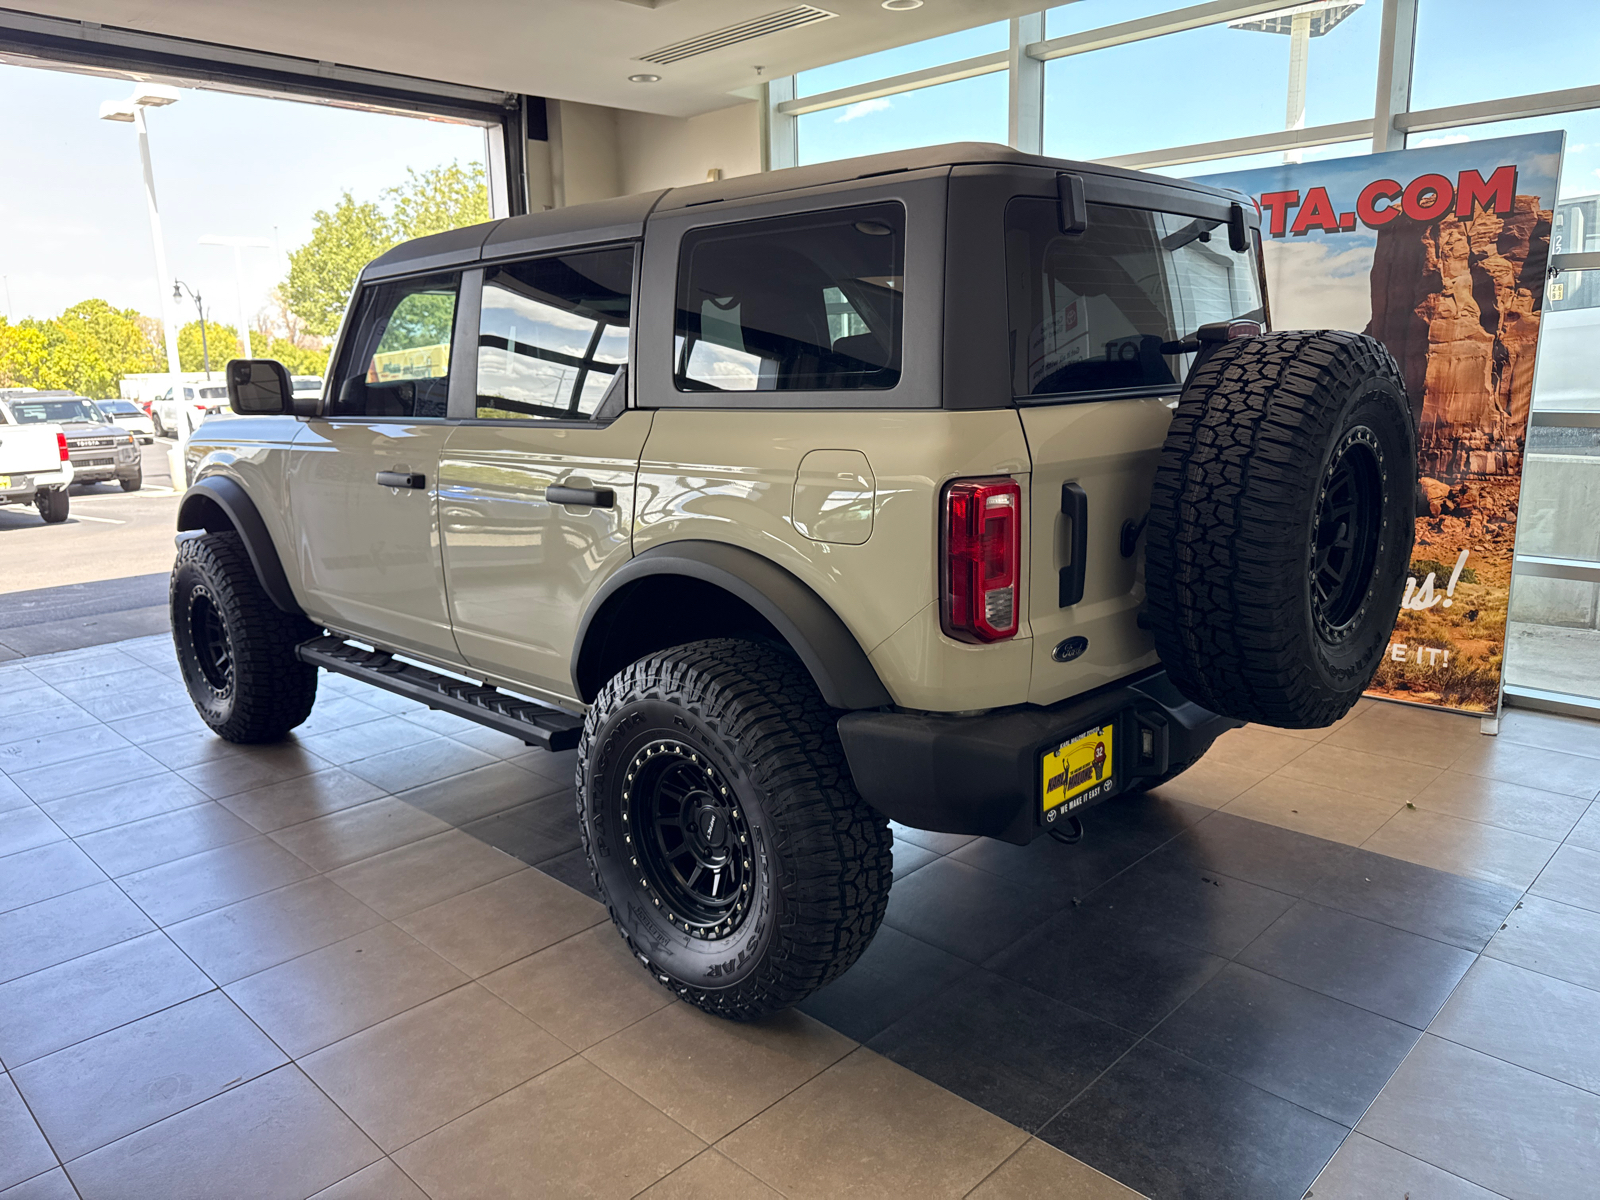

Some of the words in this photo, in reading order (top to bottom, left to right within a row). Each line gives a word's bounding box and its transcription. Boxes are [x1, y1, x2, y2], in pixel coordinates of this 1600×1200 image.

[1252, 165, 1518, 238] TA.COM
[1416, 646, 1450, 668] IT!
[1095, 746, 1104, 758] 32
[593, 711, 646, 858] PATAGONIA
[1060, 804, 1068, 814] WE
[1069, 796, 1082, 811] MAKE
[1083, 794, 1088, 803] IT
[1088, 787, 1100, 800] EASY
